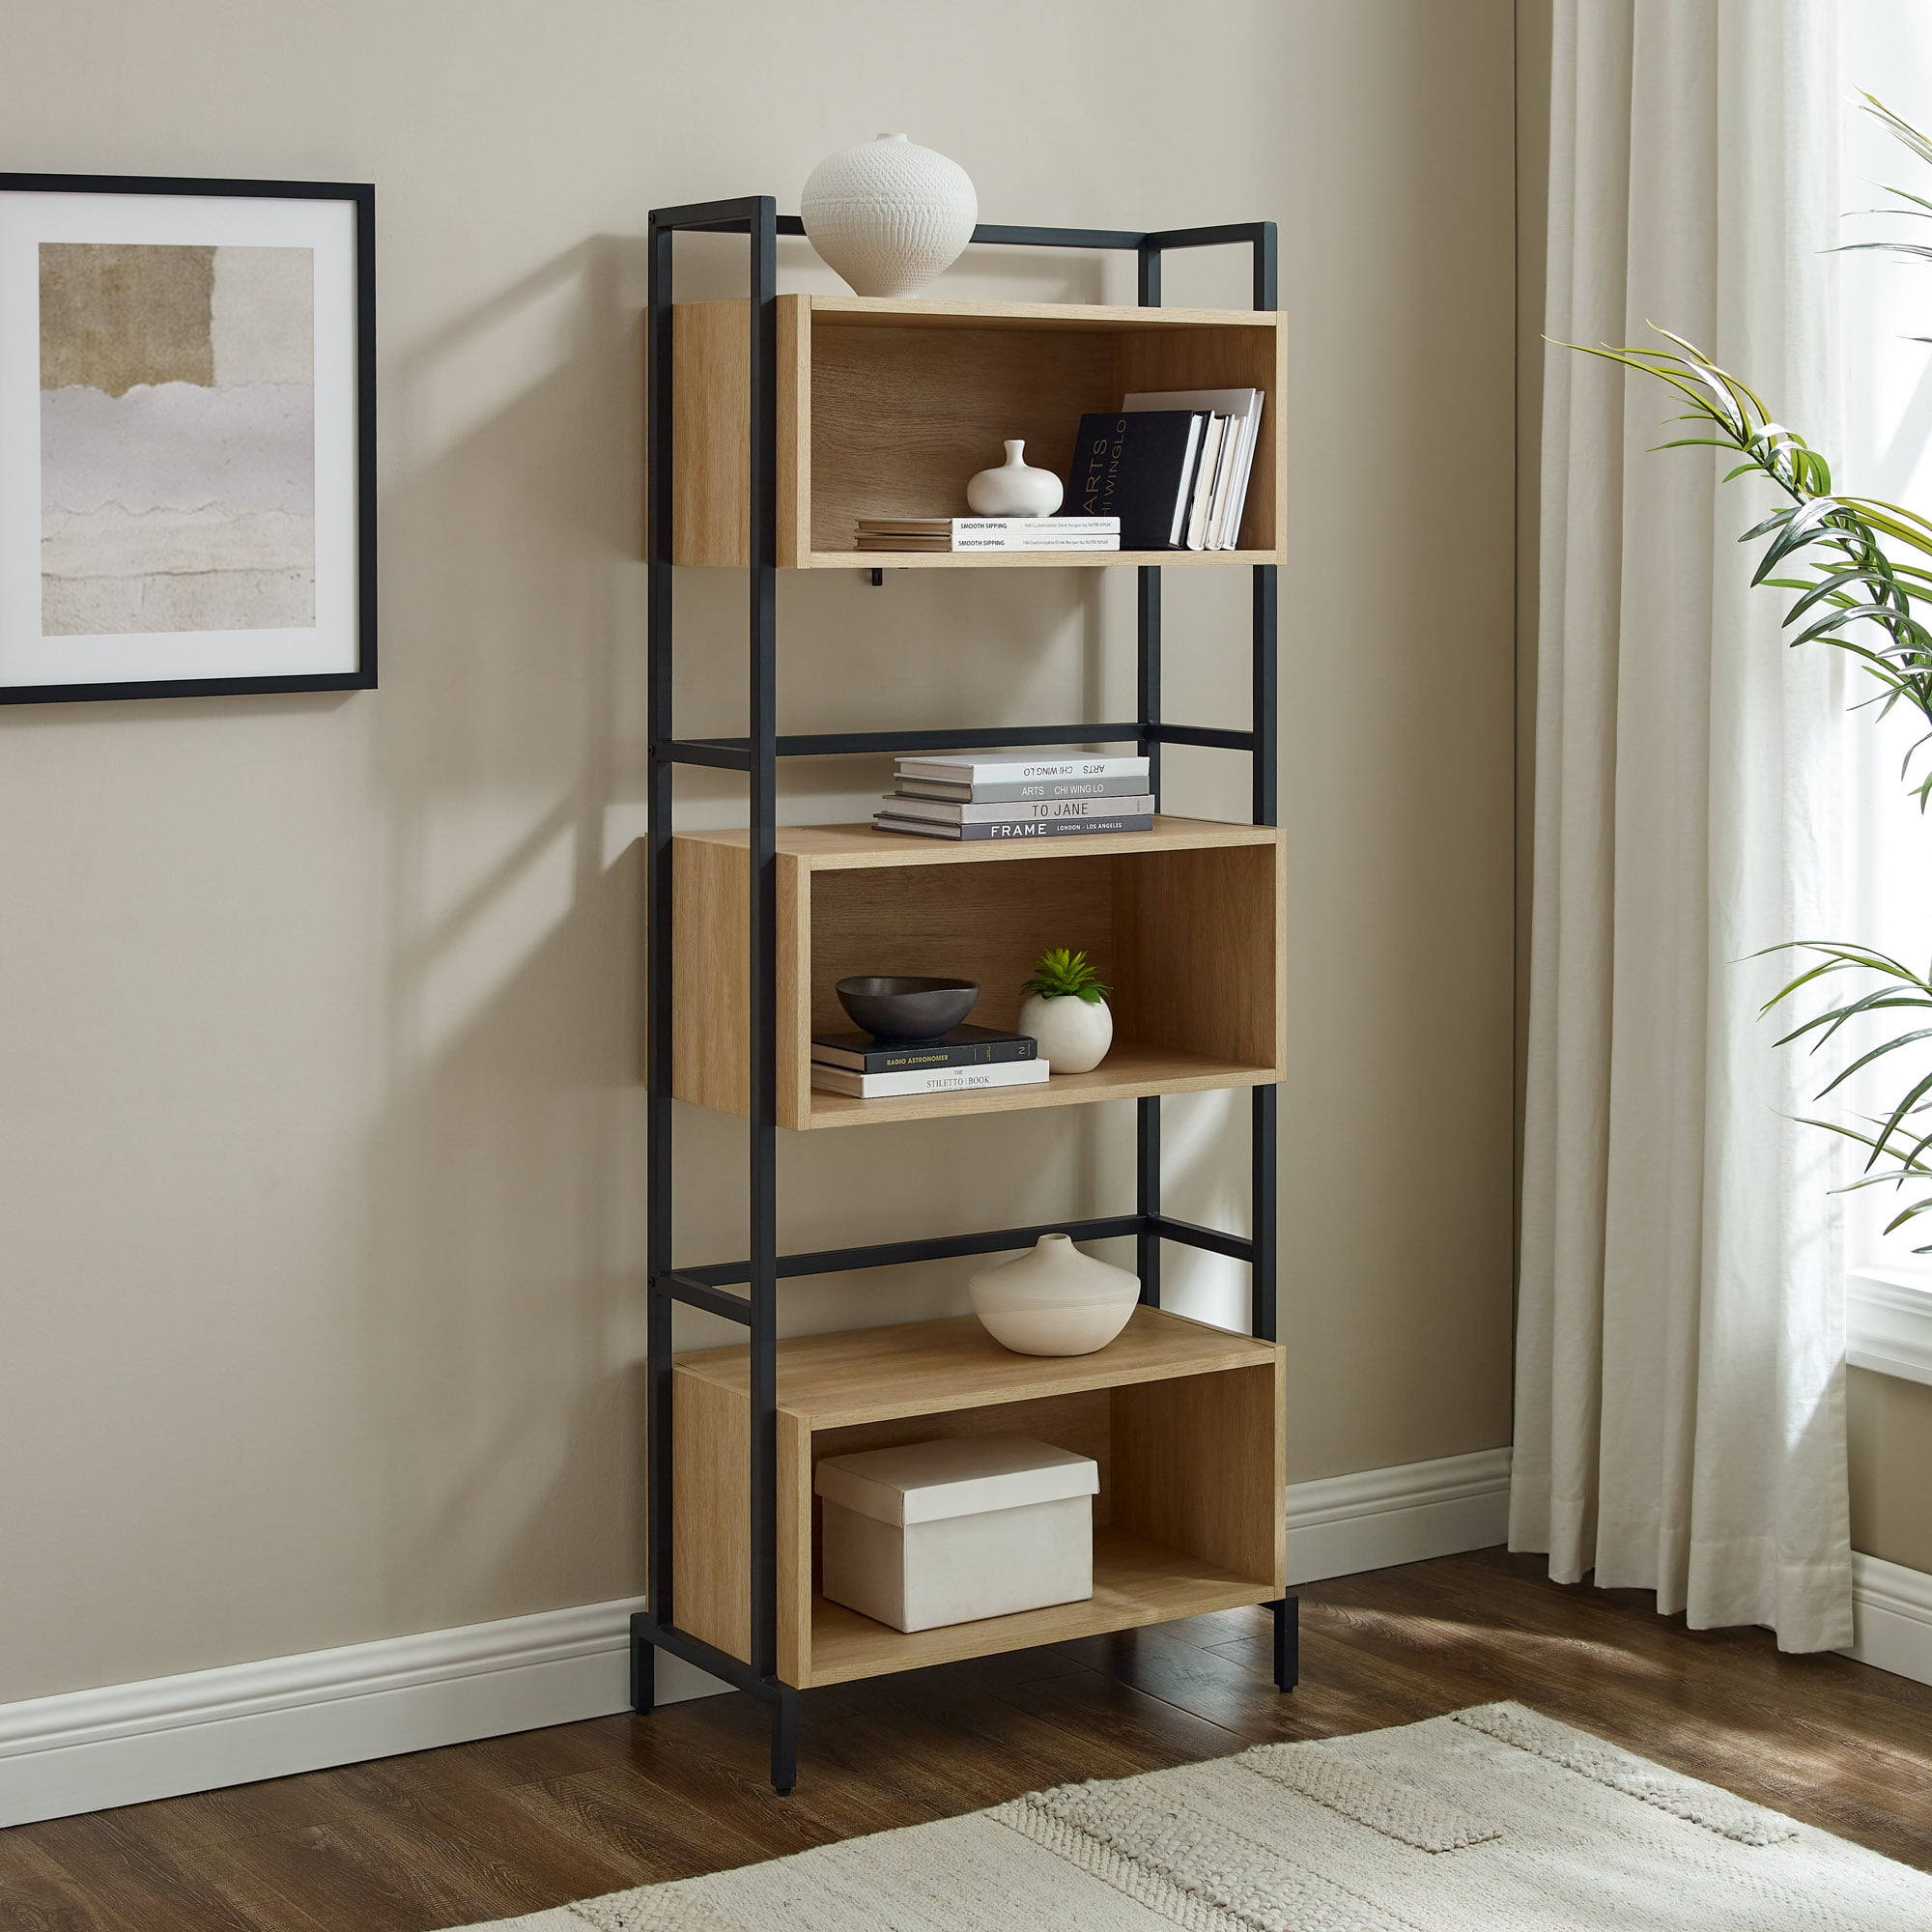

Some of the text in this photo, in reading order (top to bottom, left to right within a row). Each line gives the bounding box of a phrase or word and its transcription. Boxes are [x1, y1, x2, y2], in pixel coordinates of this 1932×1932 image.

[1083, 439, 1107, 515] ARTS
[1024, 768, 1036, 777] LO
[1037, 767, 1059, 776] WING
[1083, 764, 1105, 774] ARTS
[1022, 783, 1104, 796] ARTS CHI WING LO
[1032, 803, 1089, 817] TO JANE
[991, 824, 1047, 838] FRAME
[886, 1054, 949, 1066] RADIO ASTRONOMER
[926, 1077, 964, 1089] STILETTO
[968, 1075, 990, 1085] BOOK
